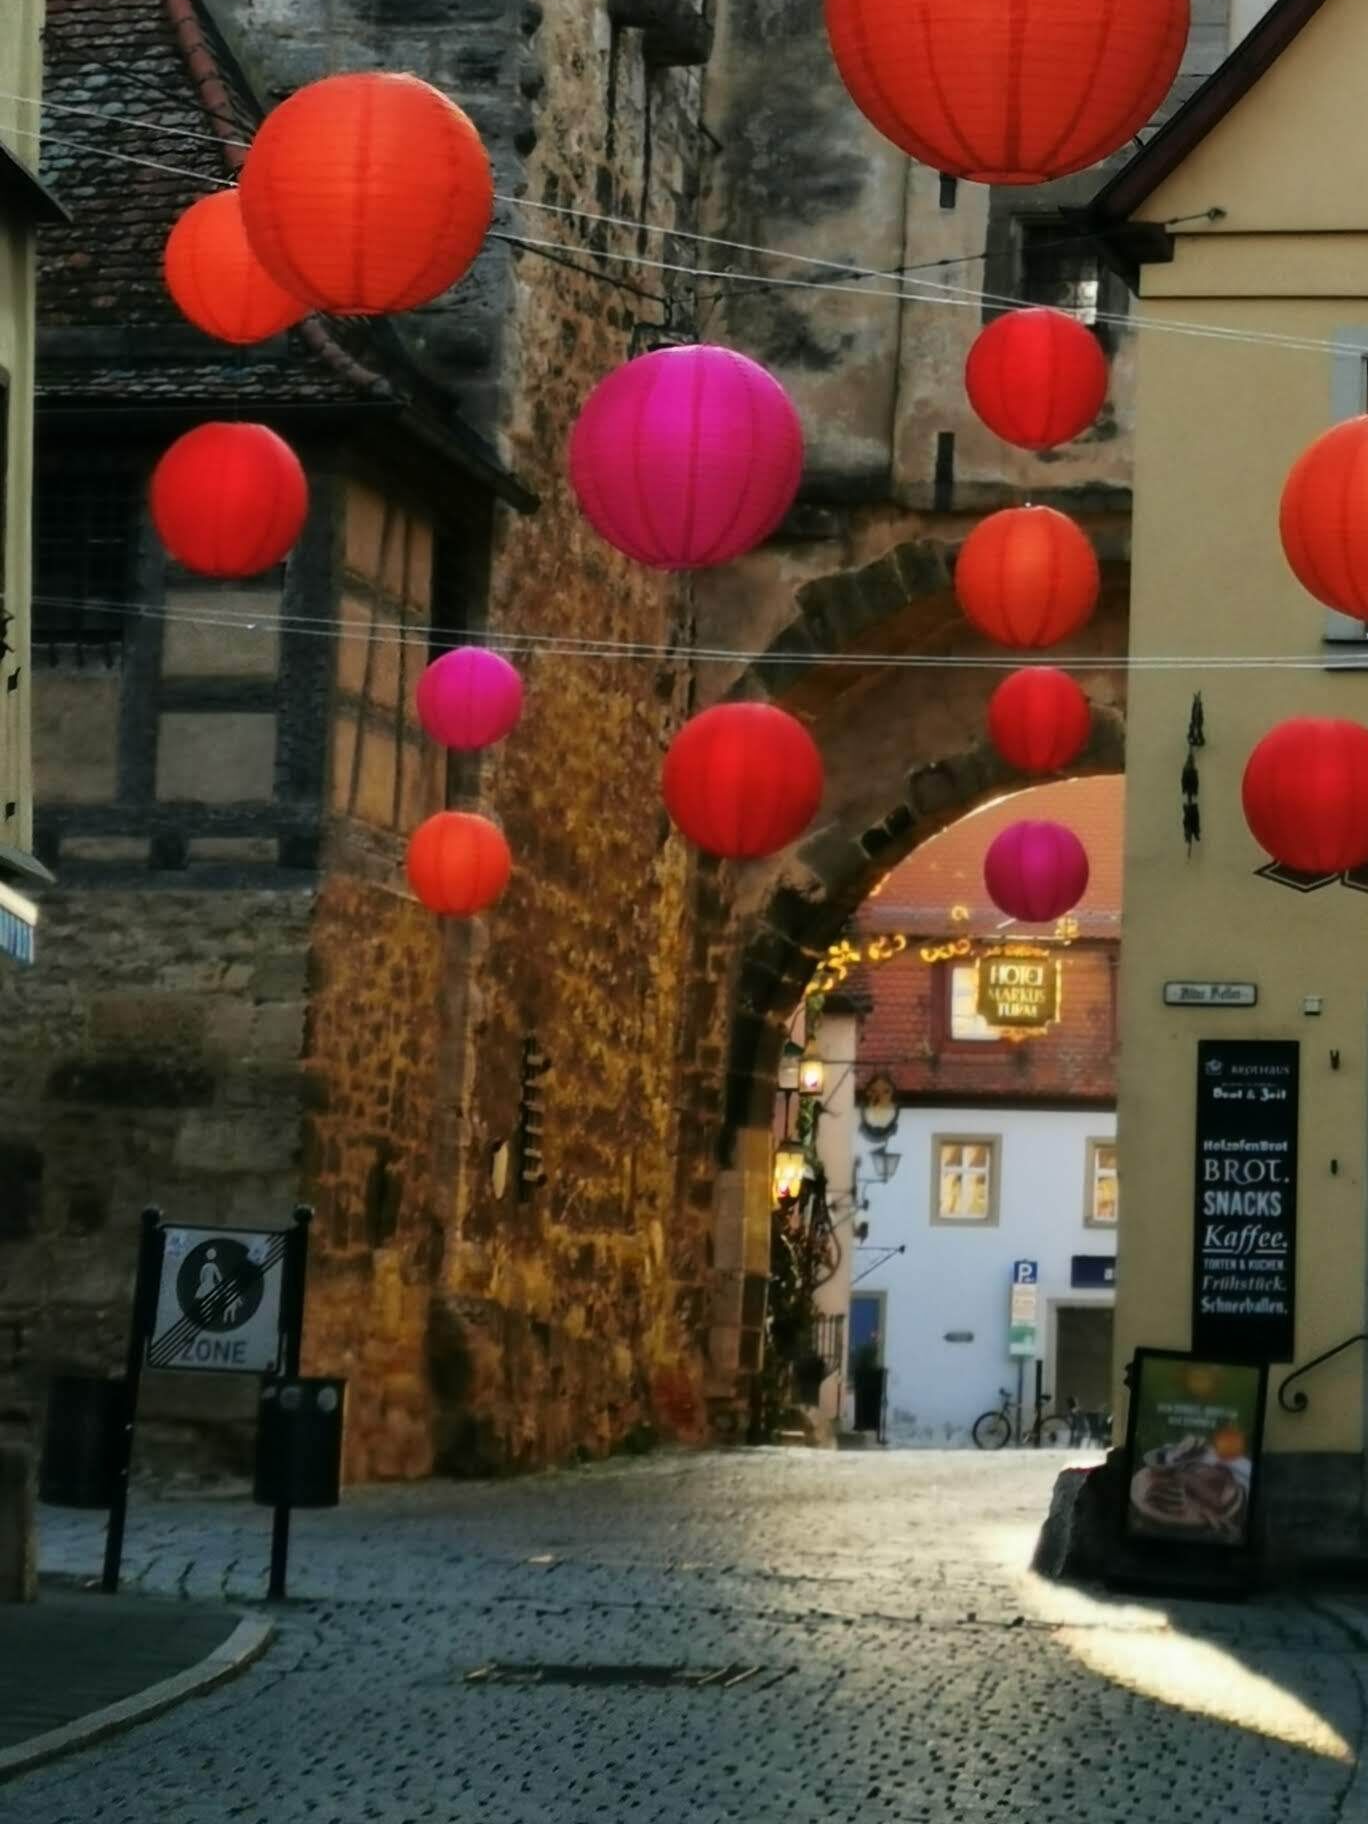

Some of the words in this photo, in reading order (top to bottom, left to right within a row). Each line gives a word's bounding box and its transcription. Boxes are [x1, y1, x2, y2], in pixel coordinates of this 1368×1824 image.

[988, 987, 1046, 1004] MARKUS
[1212, 1086, 1243, 1100] Brot
[1203, 1158, 1290, 1185] BROT.
[1203, 1189, 1282, 1217] SNACKS
[1203, 1223, 1289, 1255] Kaffee.
[1203, 1258, 1237, 1271] TORTEN
[1239, 1258, 1246, 1271] &
[180, 1339, 248, 1364] ZONE
